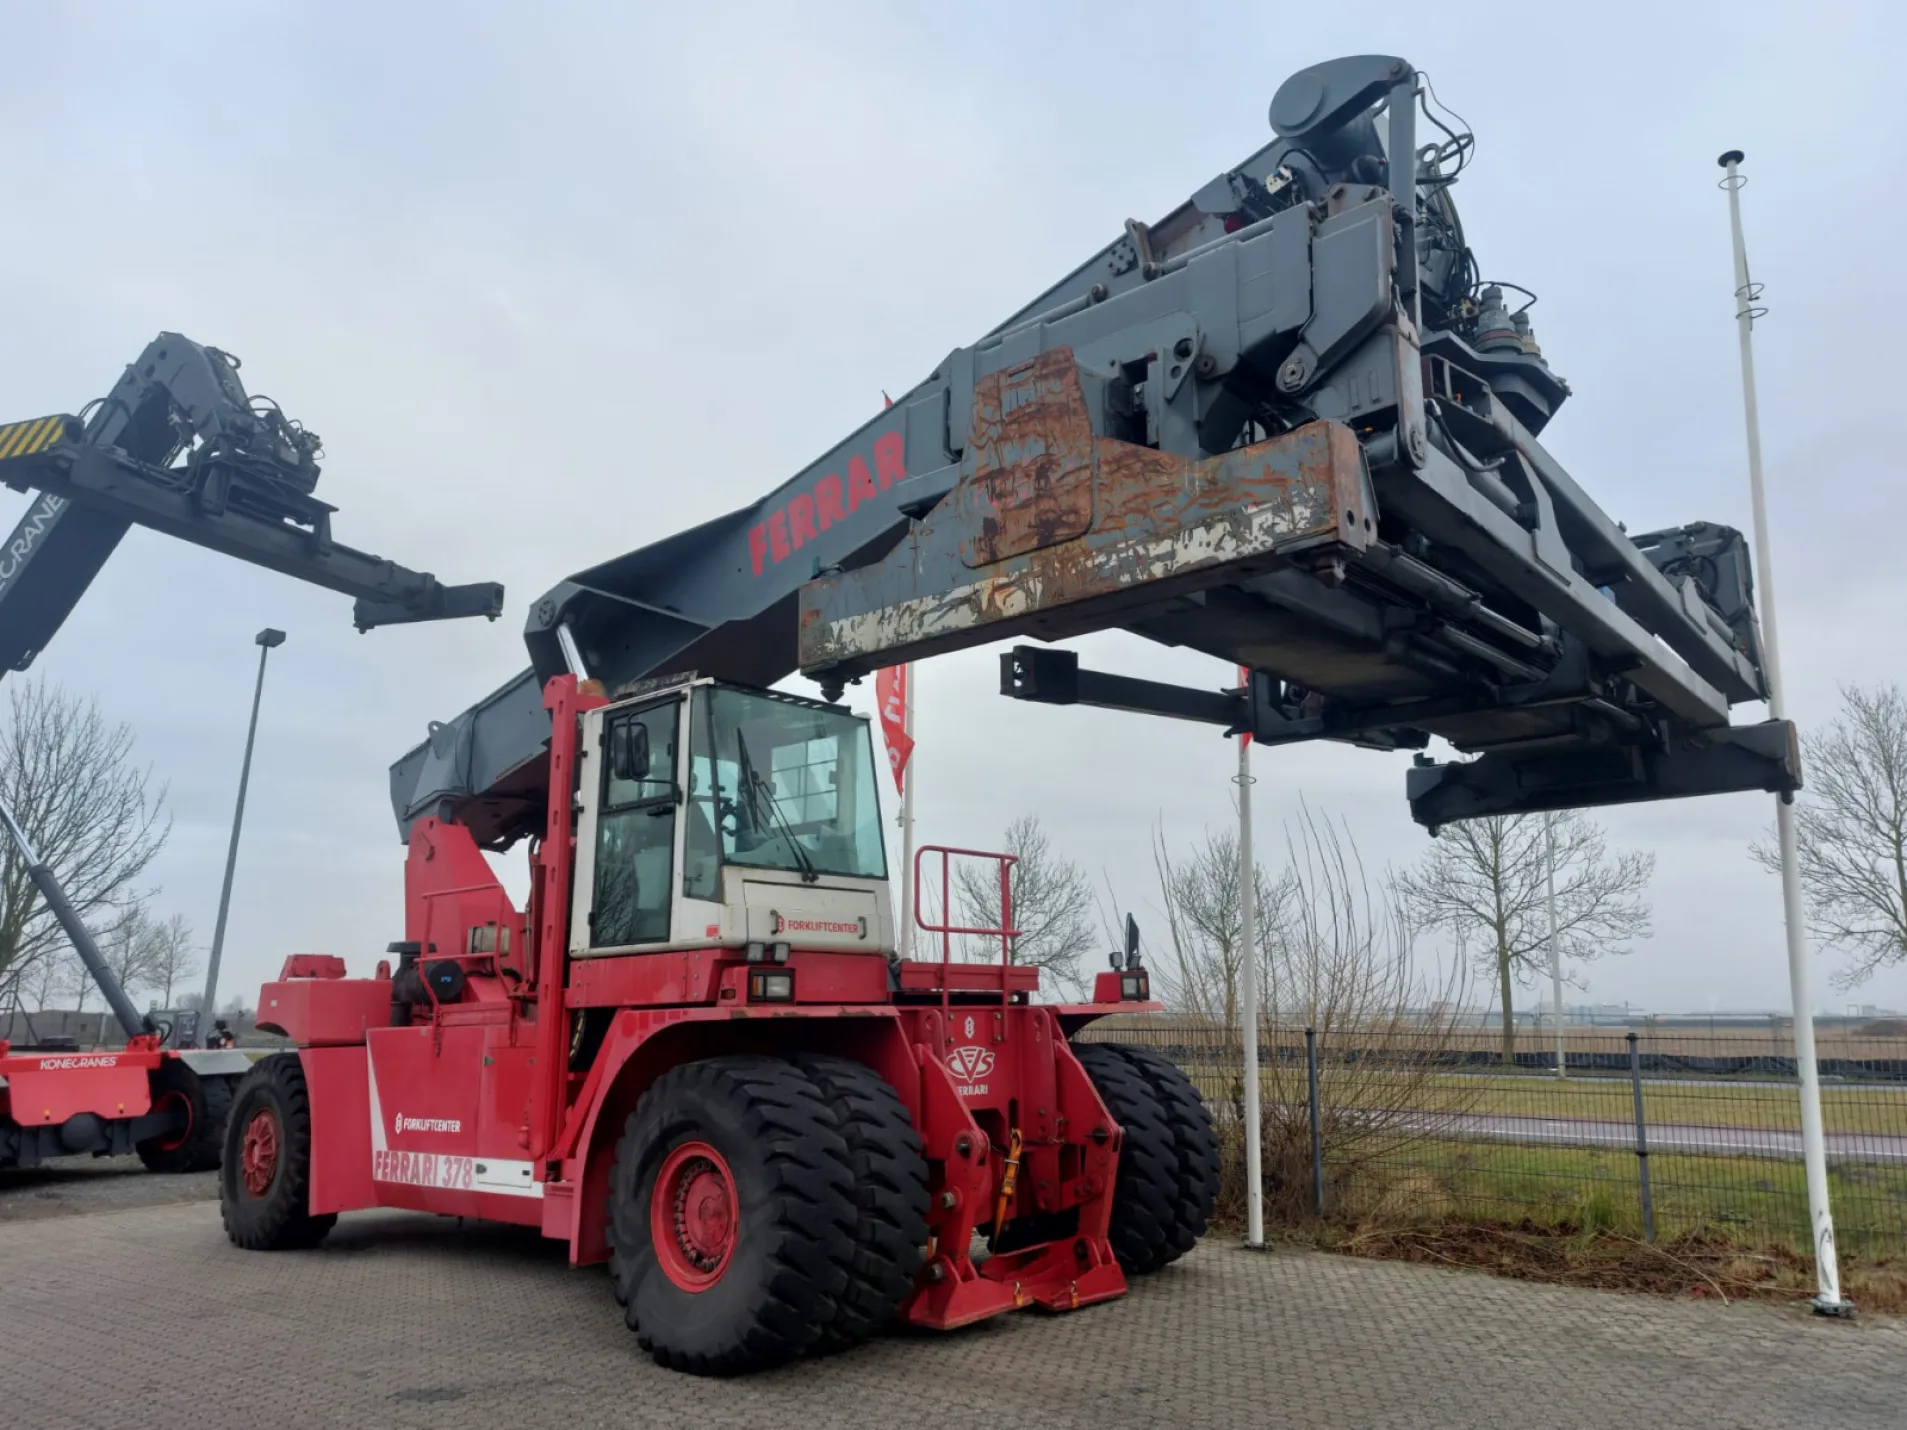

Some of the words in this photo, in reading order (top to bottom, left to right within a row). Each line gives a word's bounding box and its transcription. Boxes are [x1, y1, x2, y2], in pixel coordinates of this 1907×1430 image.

[748, 421, 907, 577] FERRAR
[0, 494, 64, 592] CRANE
[788, 920, 859, 933] FORKLIFTCENTER
[40, 1056, 117, 1070] KONECRANES
[403, 1118, 461, 1133] FORKLIFTCENTER
[374, 1150, 438, 1187] FERRARI
[442, 1156, 473, 1188] 378
